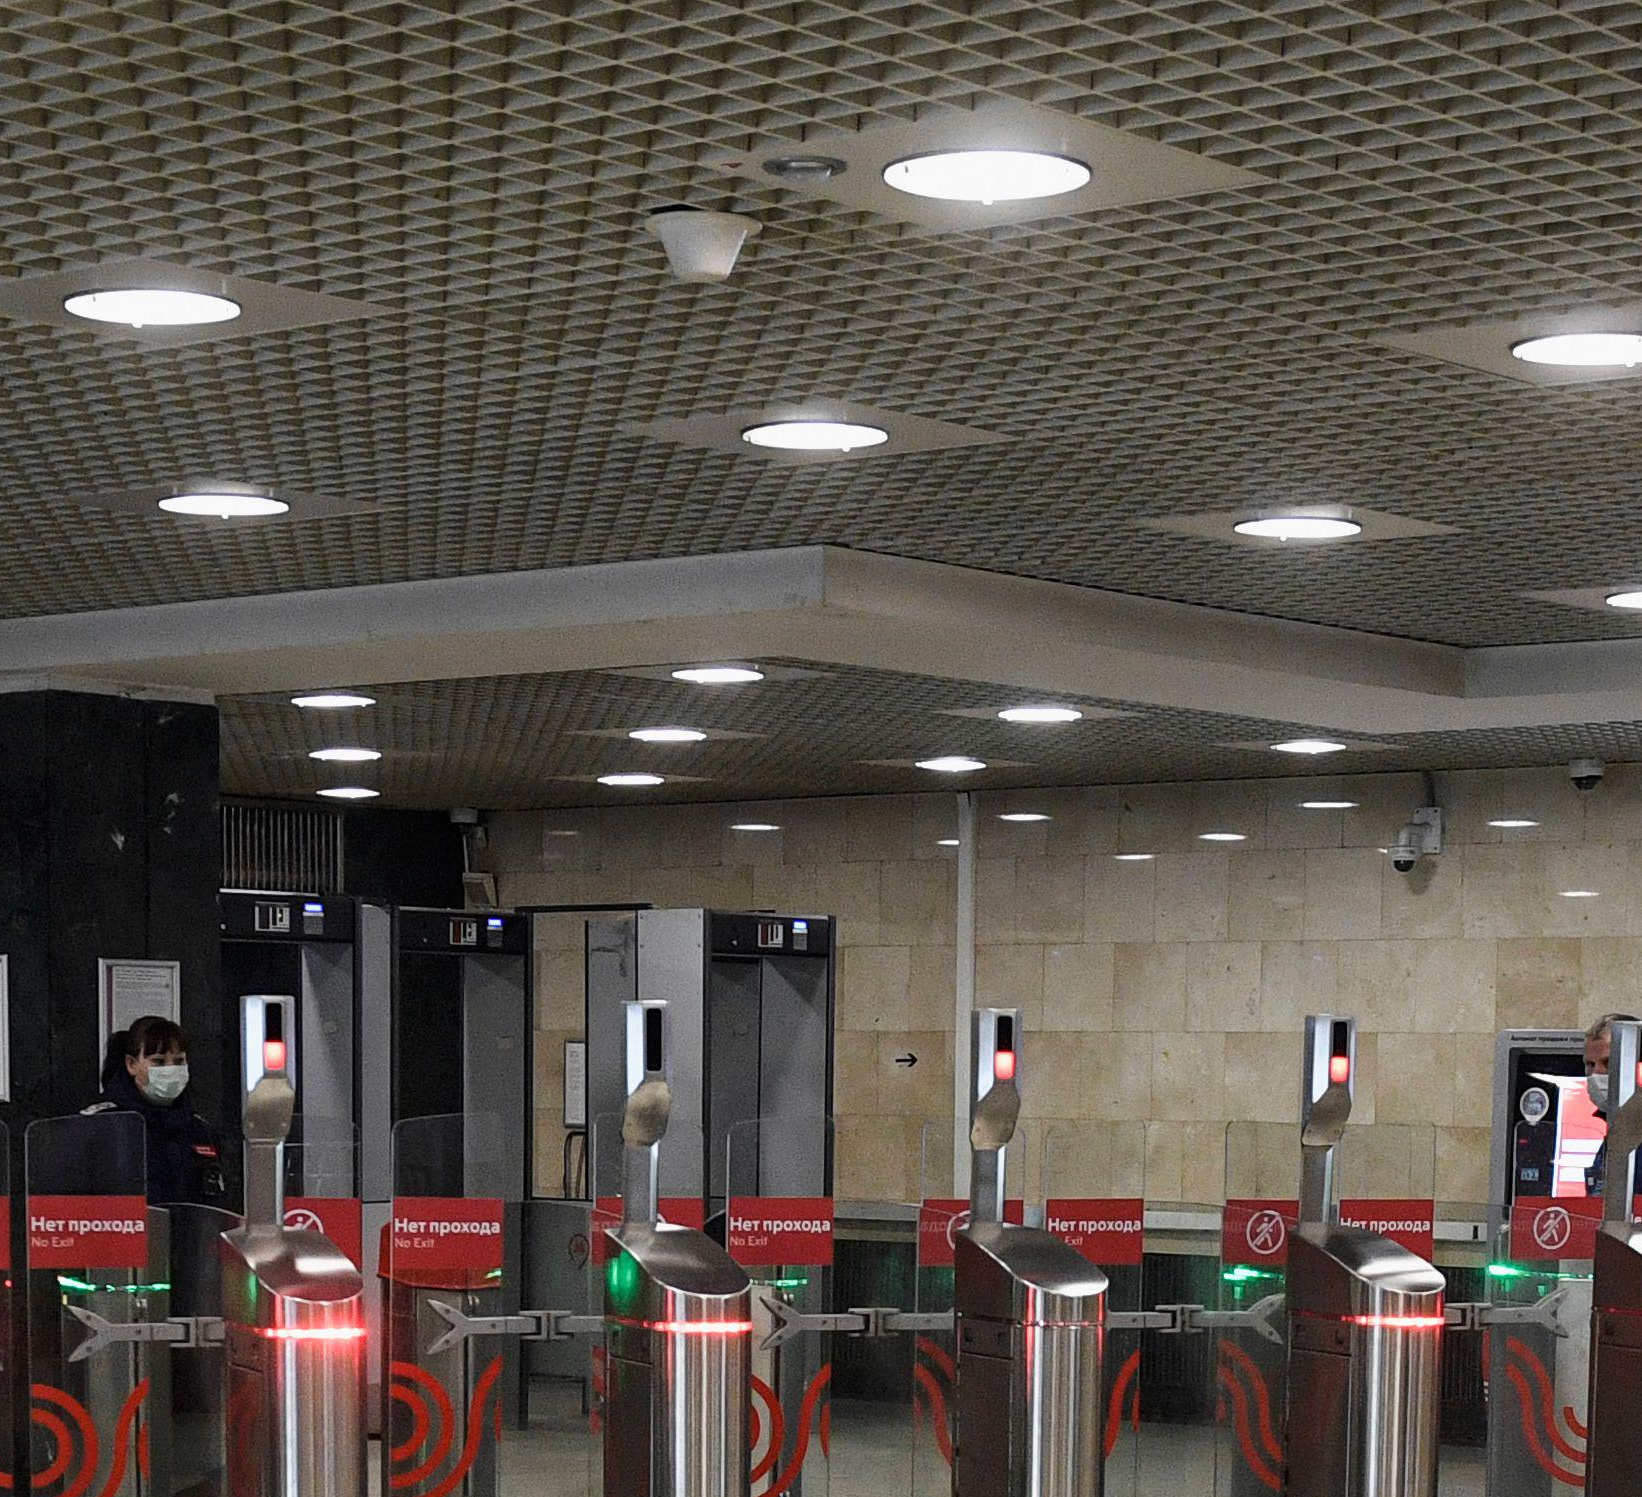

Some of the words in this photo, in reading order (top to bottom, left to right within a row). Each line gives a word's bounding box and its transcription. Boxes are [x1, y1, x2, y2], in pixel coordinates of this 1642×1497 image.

[31, 1217, 65, 1231] Нет
[69, 1220, 144, 1234] прохода
[395, 1218, 426, 1233] Нет
[430, 1222, 500, 1236] прохода
[730, 1217, 760, 1231] Нет
[764, 1221, 830, 1234] прохода
[1048, 1218, 1076, 1232] Нет
[1079, 1221, 1141, 1234] прохода
[1370, 1221, 1430, 1234] прохода
[31, 1237, 49, 1247] No
[52, 1237, 74, 1247] Exit
[395, 1238, 411, 1248] No
[414, 1238, 434, 1248] Exit
[730, 1236, 745, 1246] No
[748, 1236, 767, 1246] Exit
[1065, 1236, 1083, 1246] Exit
